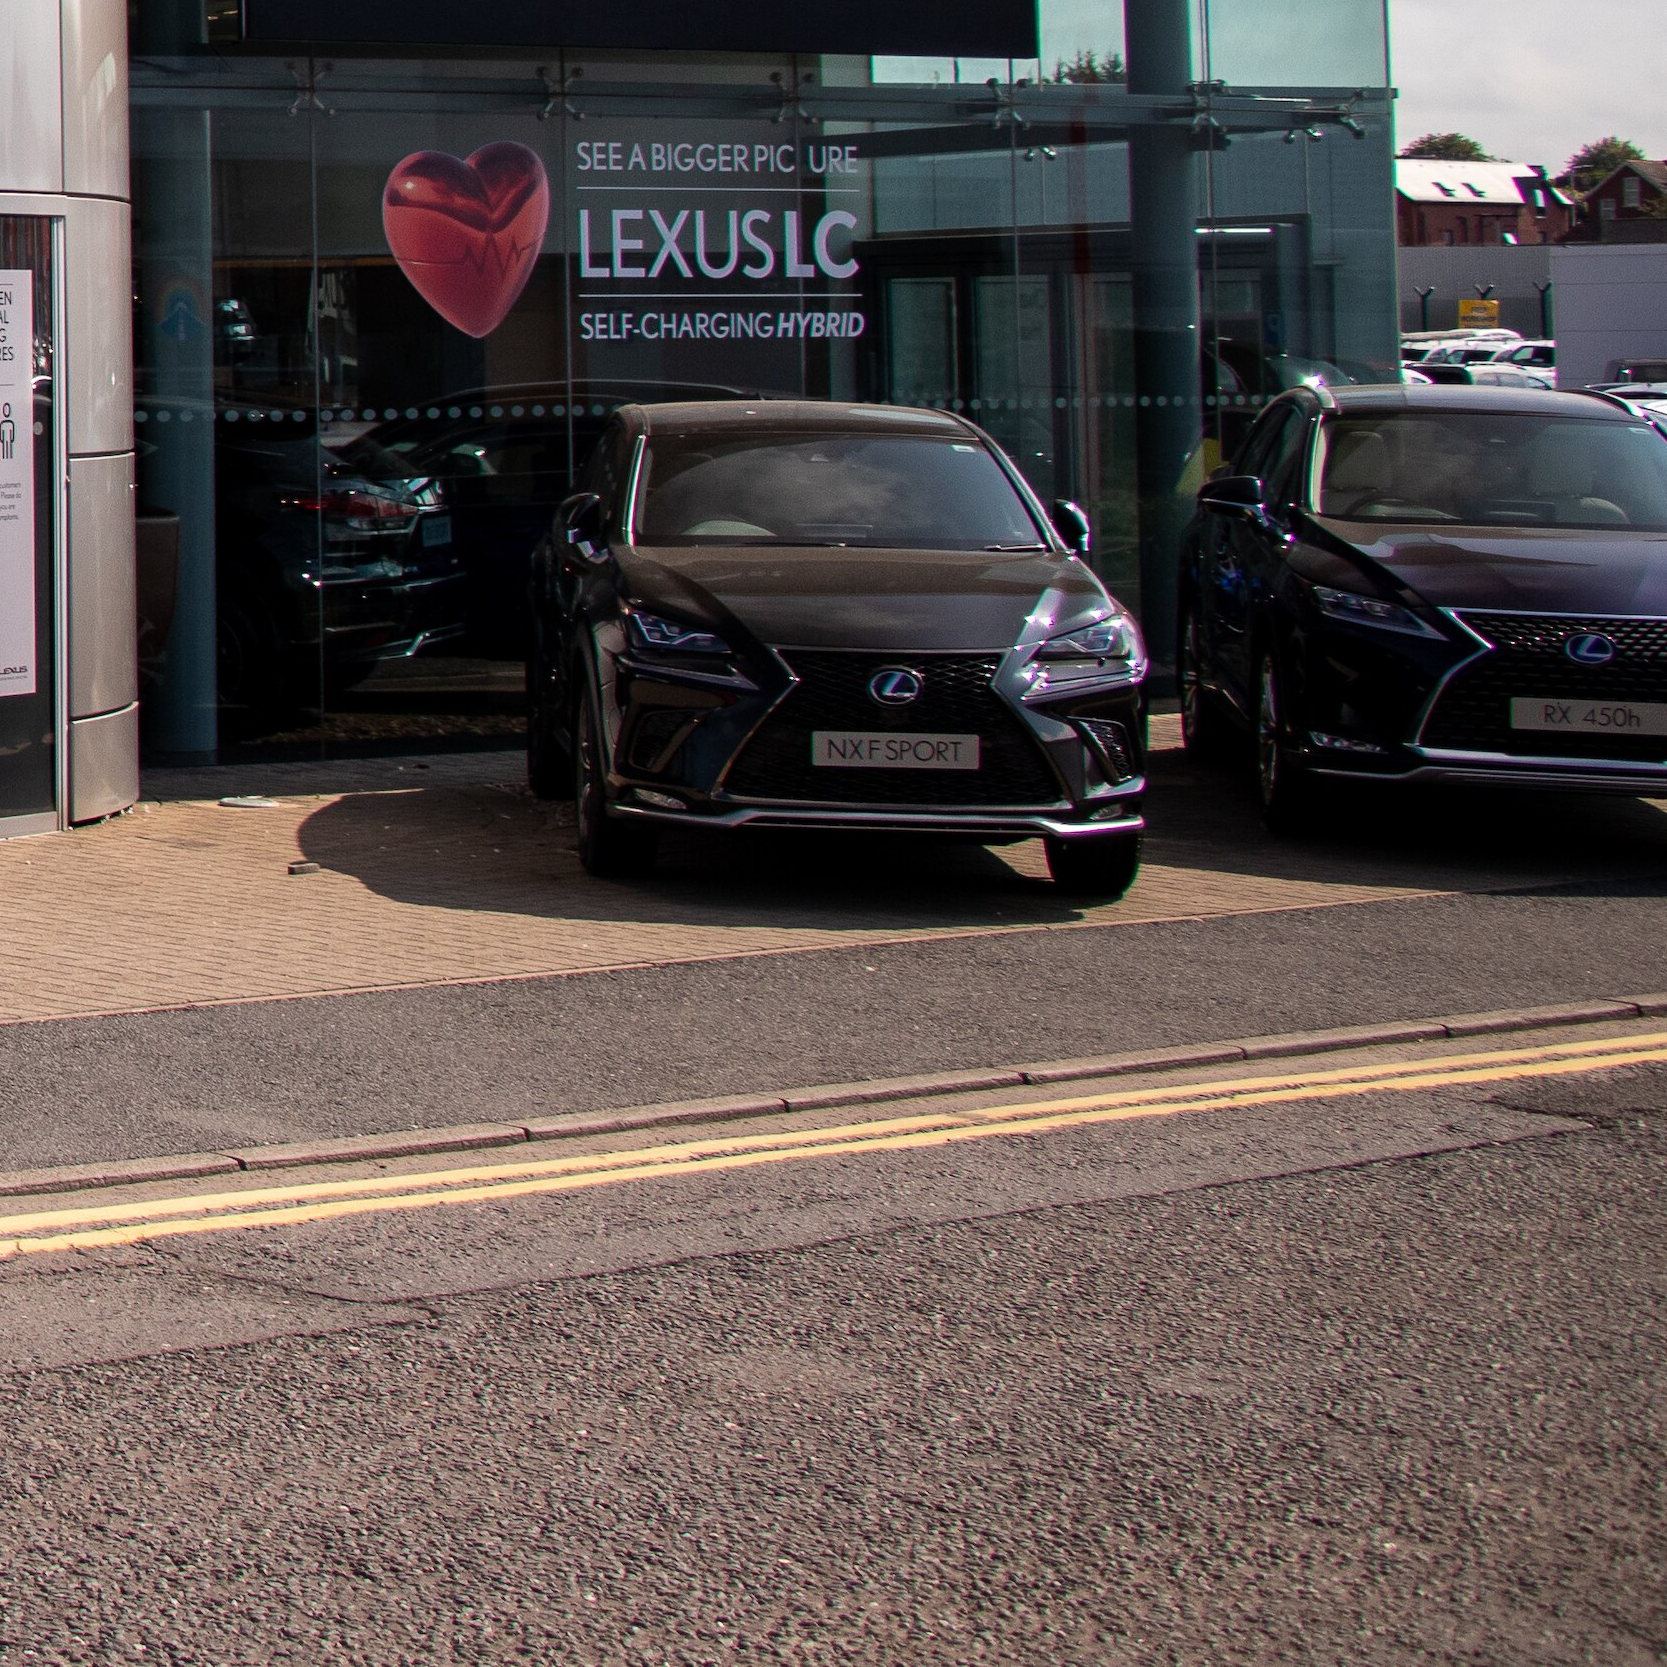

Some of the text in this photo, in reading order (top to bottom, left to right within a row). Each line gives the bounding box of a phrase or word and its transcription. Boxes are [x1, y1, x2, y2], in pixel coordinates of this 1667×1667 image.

[577, 142, 858, 173] SEE A BIGGER PICURE
[579, 209, 859, 278] LEXUS LC
[580, 312, 865, 340] SELF-CHARGING HYBRID
[1544, 704, 1641, 727] RX 450h
[827, 739, 963, 762] NX F SPORT
